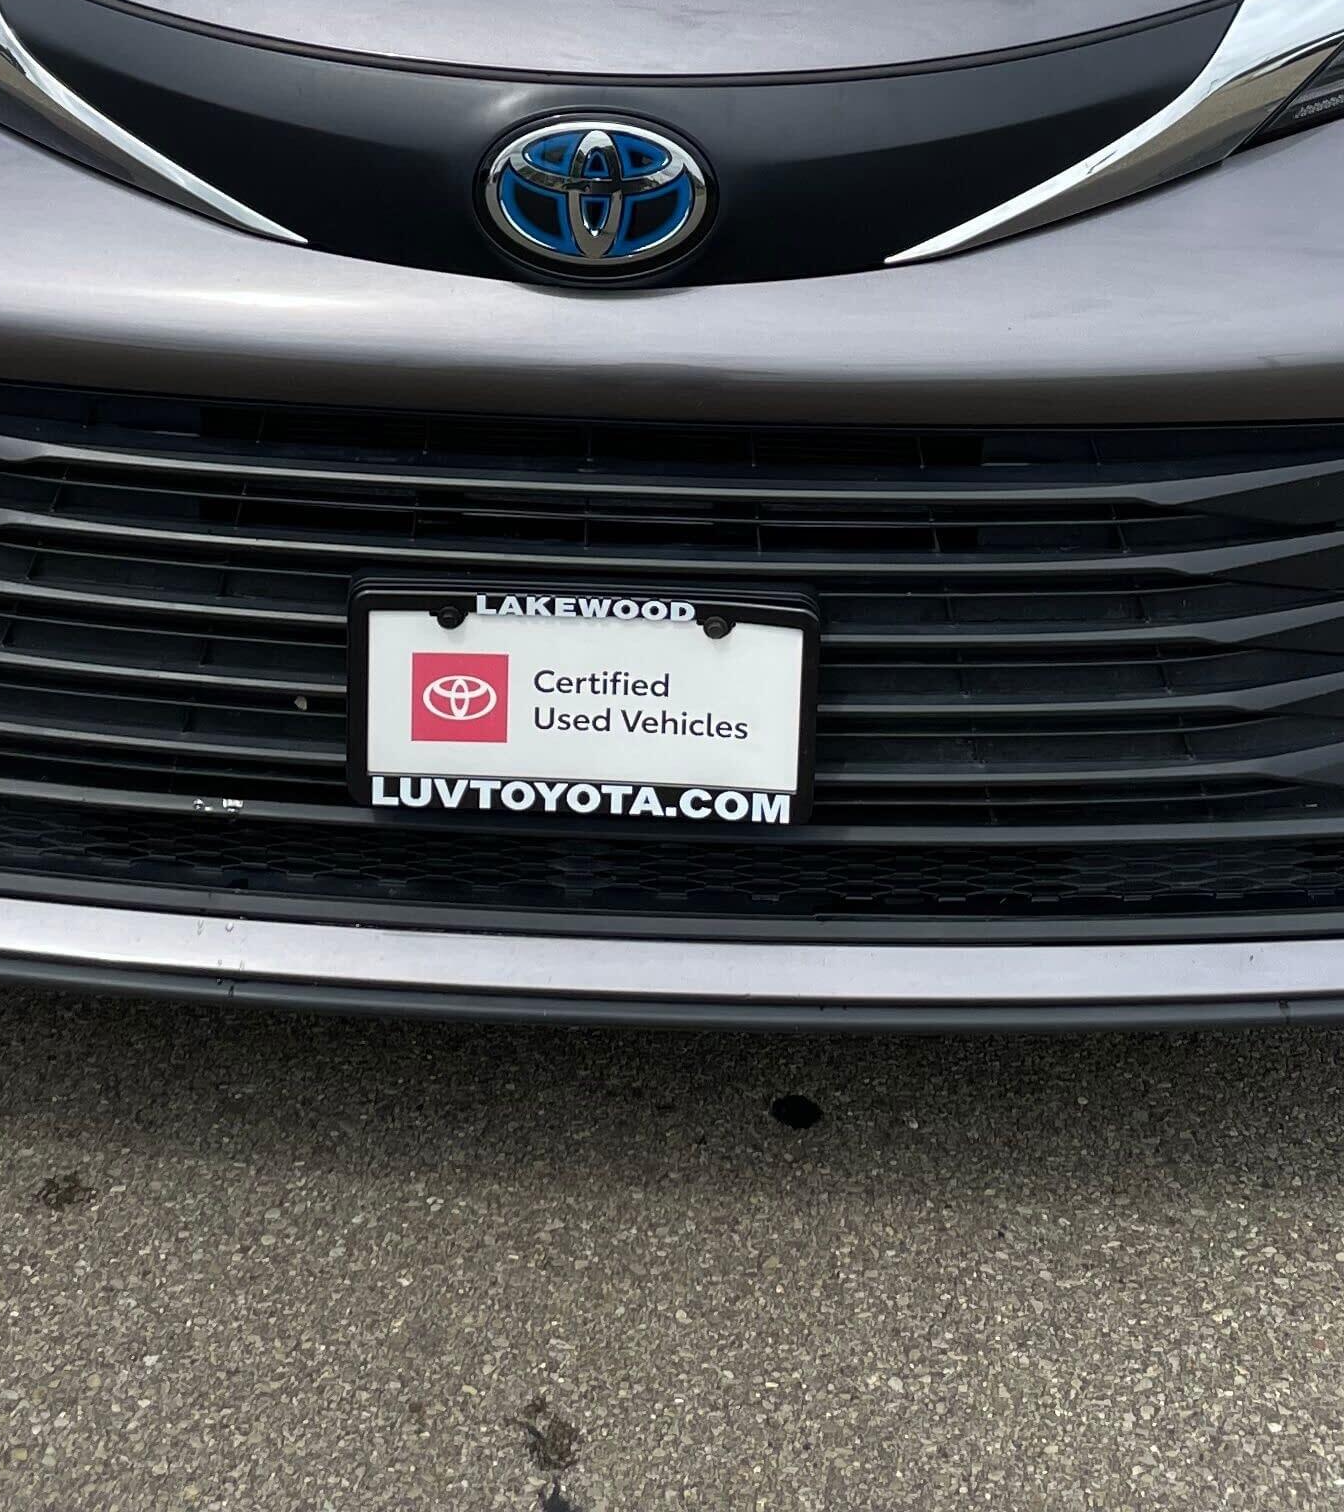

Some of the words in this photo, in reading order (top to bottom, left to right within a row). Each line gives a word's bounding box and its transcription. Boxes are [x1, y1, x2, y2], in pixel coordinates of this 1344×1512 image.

[475, 593, 697, 623] LAKEWOOD
[533, 669, 671, 698] Certified
[533, 706, 612, 733] Used
[619, 708, 749, 740] Vehicles
[371, 775, 792, 824] LUVTOYOTA.COM
